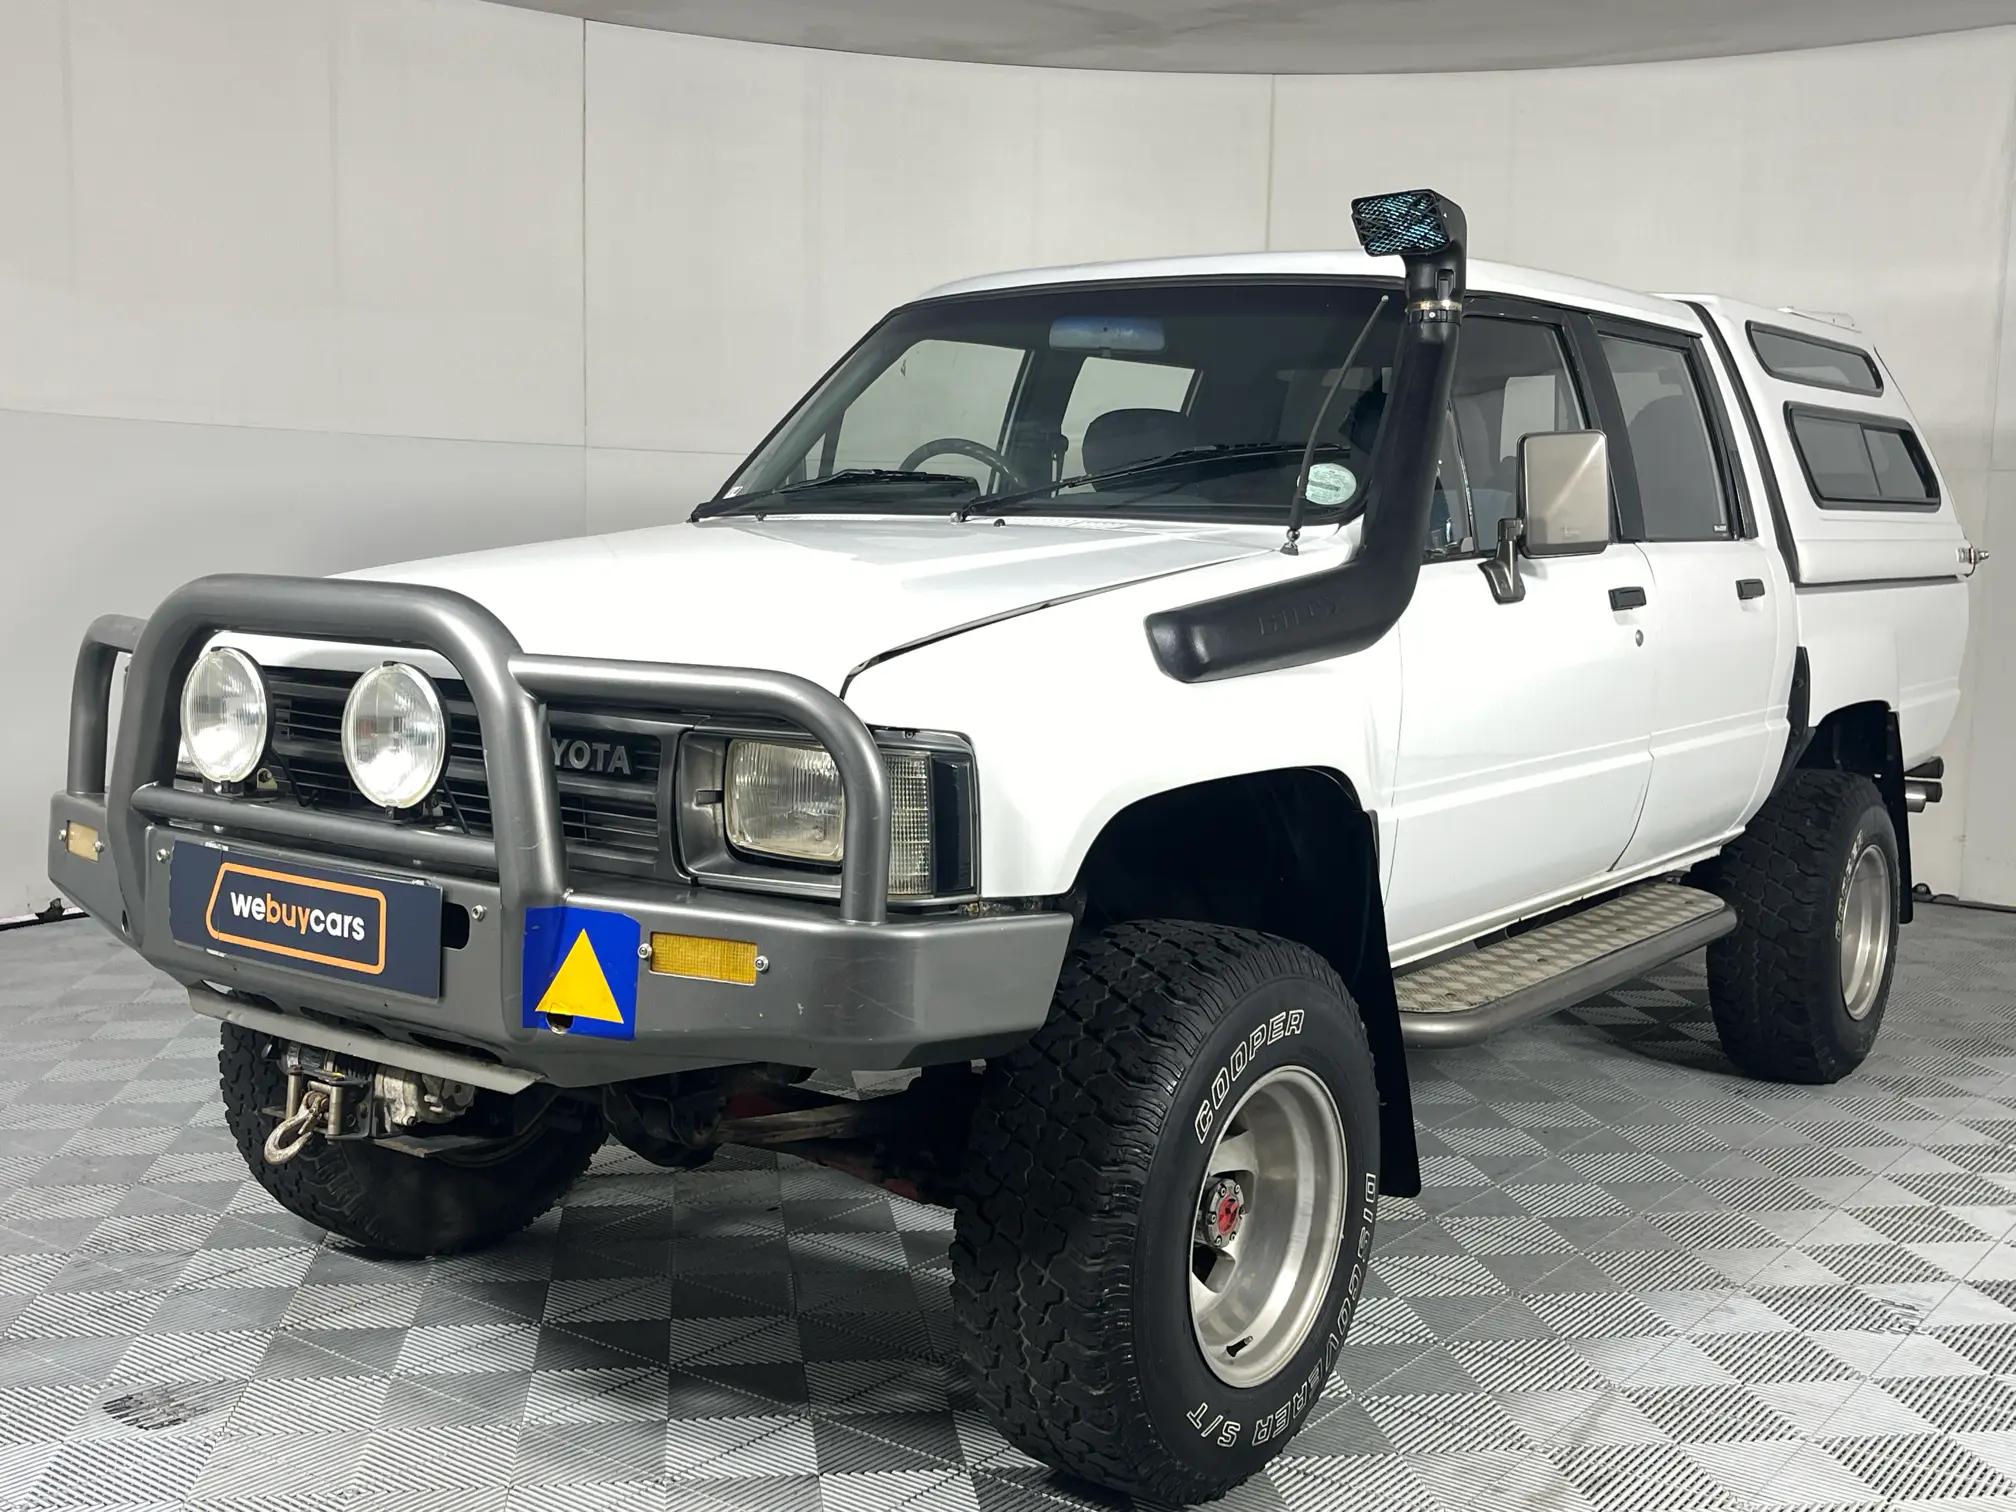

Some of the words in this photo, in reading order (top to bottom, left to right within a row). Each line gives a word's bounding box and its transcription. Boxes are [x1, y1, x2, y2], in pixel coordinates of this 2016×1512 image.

[551, 737, 632, 776] YOTA
[230, 891, 366, 942] webuycars
[1194, 1009, 1305, 1144] COOPER
[1252, 1172, 1377, 1447] DISCOVERER
[1187, 1402, 1241, 1448] S/T
